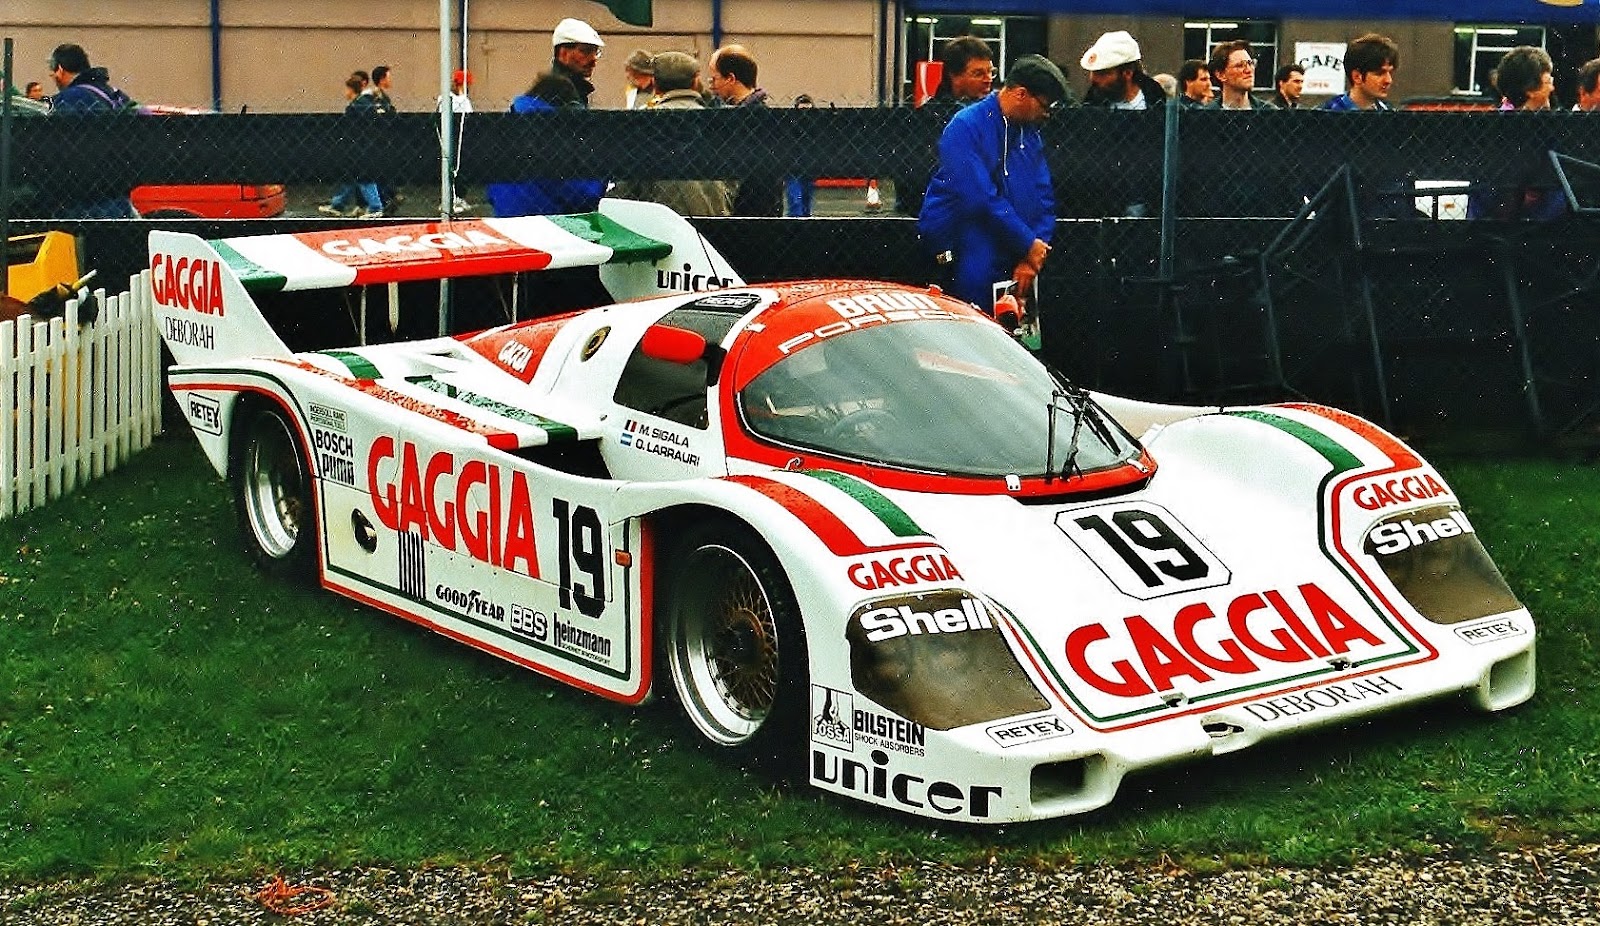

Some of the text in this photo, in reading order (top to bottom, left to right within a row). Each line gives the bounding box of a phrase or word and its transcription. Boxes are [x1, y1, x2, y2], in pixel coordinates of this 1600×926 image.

[1299, 55, 1344, 71] CAFE
[322, 229, 508, 256] GAGGIA
[151, 253, 224, 317] GAGGIA
[826, 292, 943, 319] BRUN
[165, 316, 215, 350] DEBORAH
[315, 429, 353, 458] BOSCH
[638, 424, 690, 448] M. SIGALA
[322, 453, 355, 485] PUMA
[646, 442, 701, 467] LARRAURI
[367, 435, 541, 579] GAGGIA
[1353, 474, 1449, 510] GAGGIA
[552, 497, 606, 619] 19
[1073, 509, 1209, 588] 19
[847, 554, 965, 590] GAGGIA
[510, 604, 548, 642] BBS
[553, 612, 611, 657] heinzmann
[860, 598, 993, 642] Shell
[1064, 582, 1386, 699] GAGGIA
[1243, 676, 1403, 722] DEBORAH
[854, 710, 924, 746] BILSTEIN
[854, 733, 925, 757] SHOCK ABSORBERS
[813, 749, 1003, 818] unicer
